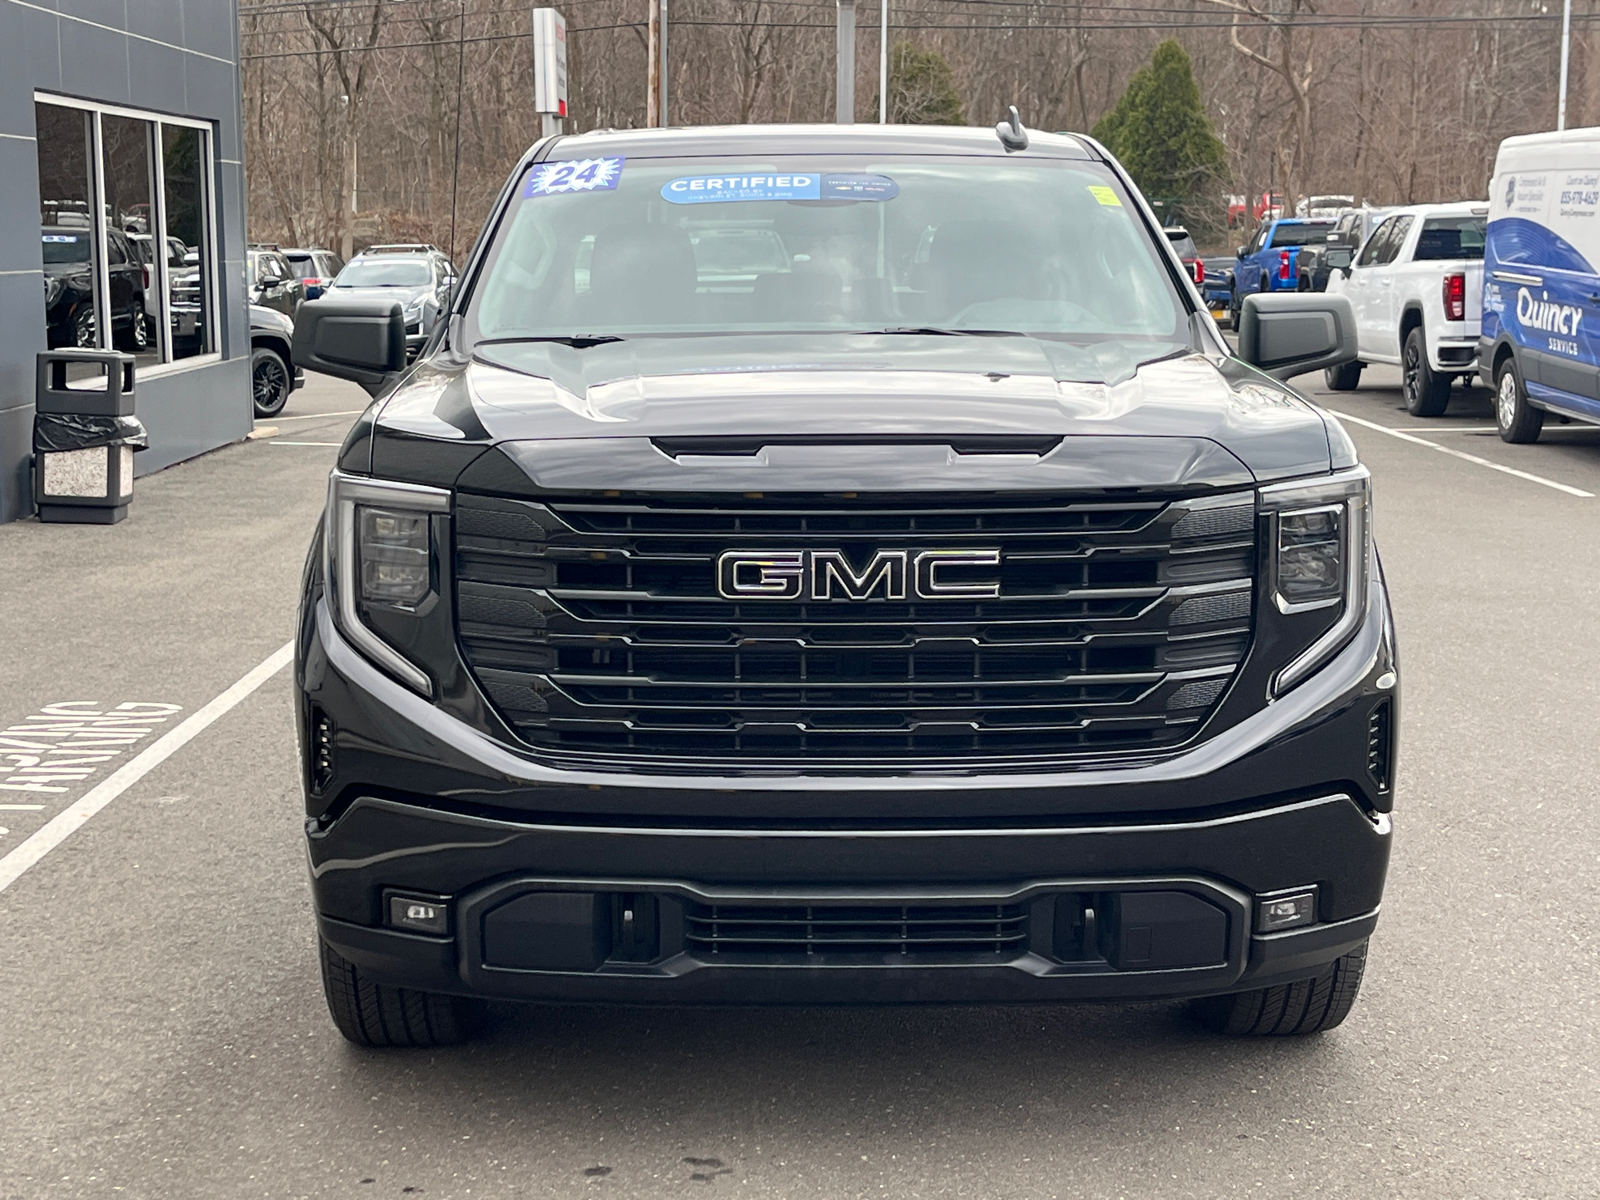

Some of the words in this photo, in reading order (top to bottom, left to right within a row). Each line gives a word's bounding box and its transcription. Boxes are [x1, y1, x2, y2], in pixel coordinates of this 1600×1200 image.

[548, 163, 599, 187] 24
[670, 176, 812, 192] CERTIFIED
[1517, 287, 1583, 336] Quincy
[1548, 337, 1579, 356] SERVICE
[718, 549, 1000, 600] GMC
